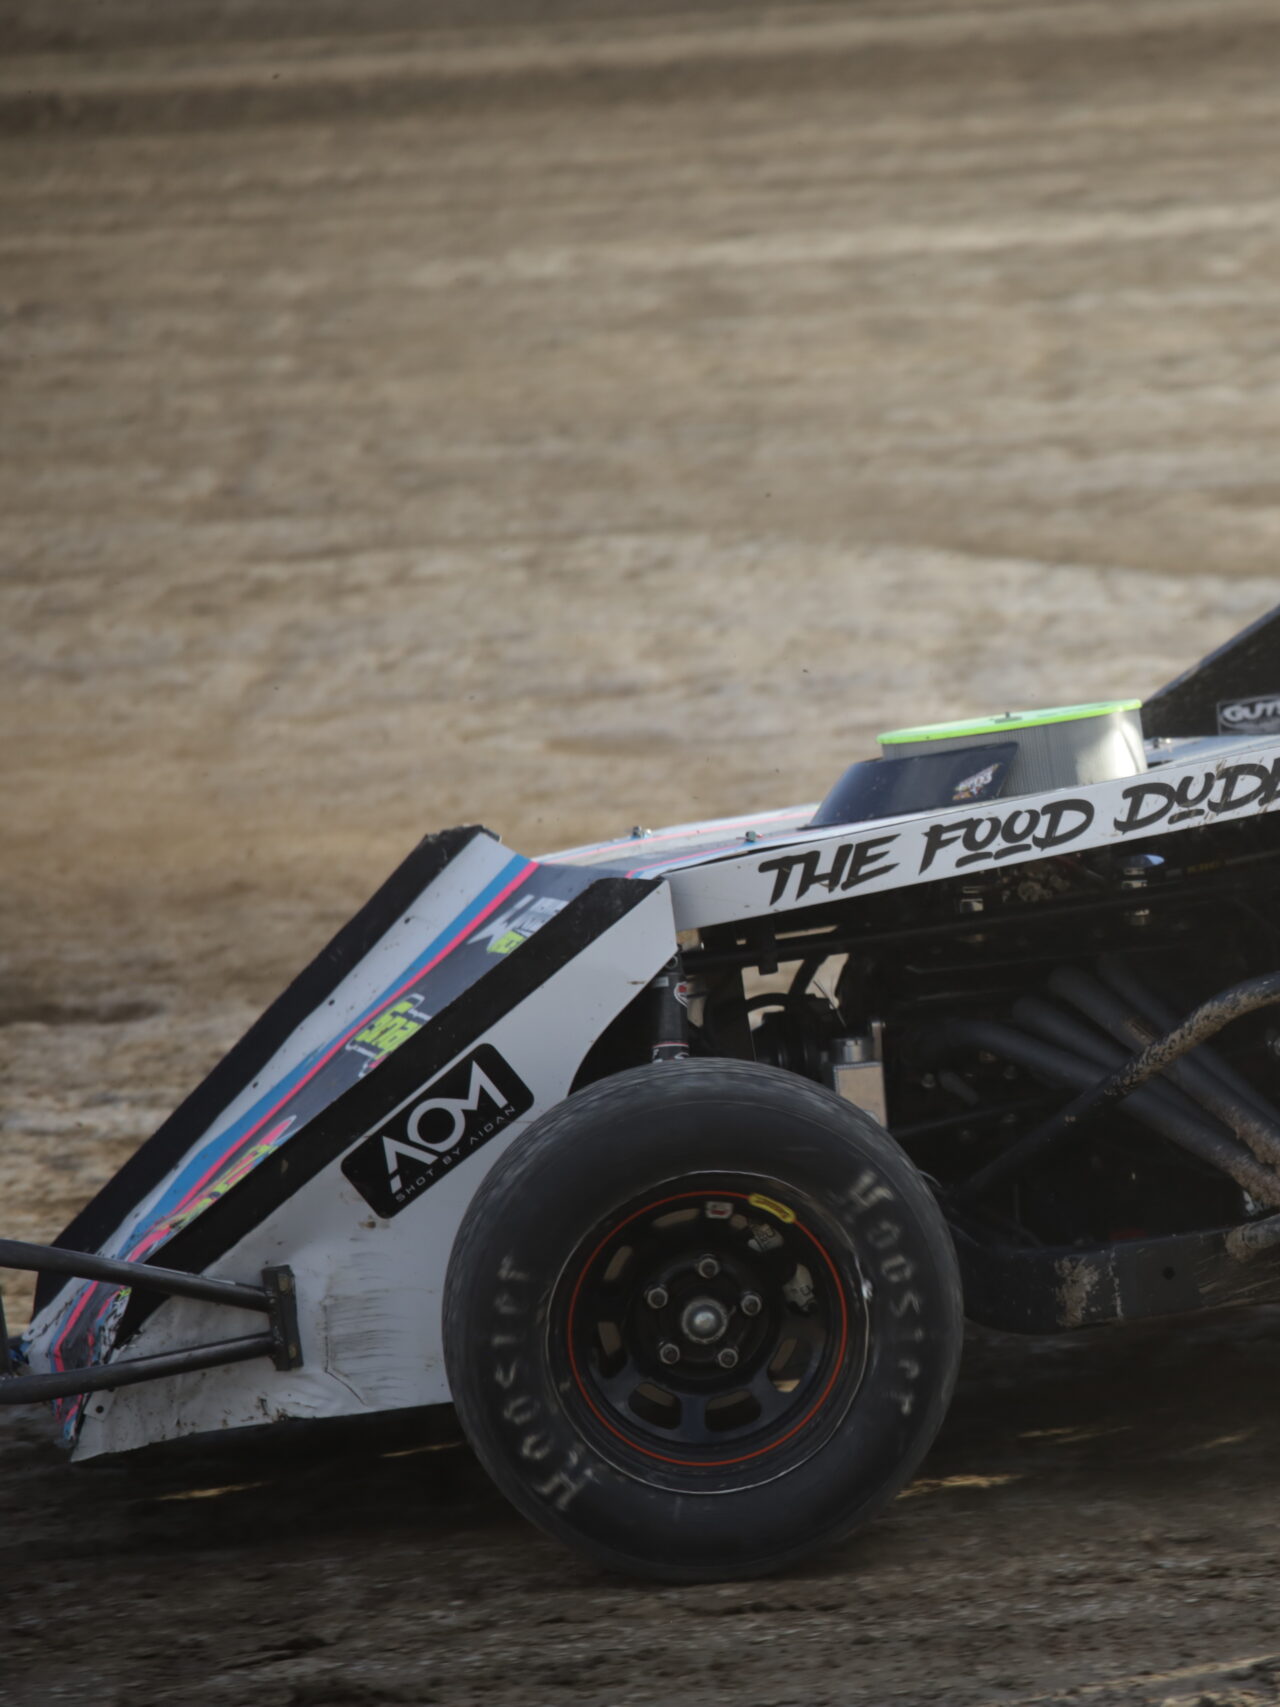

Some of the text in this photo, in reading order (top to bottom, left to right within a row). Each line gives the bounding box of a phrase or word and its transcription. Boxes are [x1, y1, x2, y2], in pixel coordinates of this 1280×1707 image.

[759, 834, 902, 907] THE
[919, 799, 1094, 875] FOOD
[395, 1106, 516, 1203] SHOT BY AIDAN
